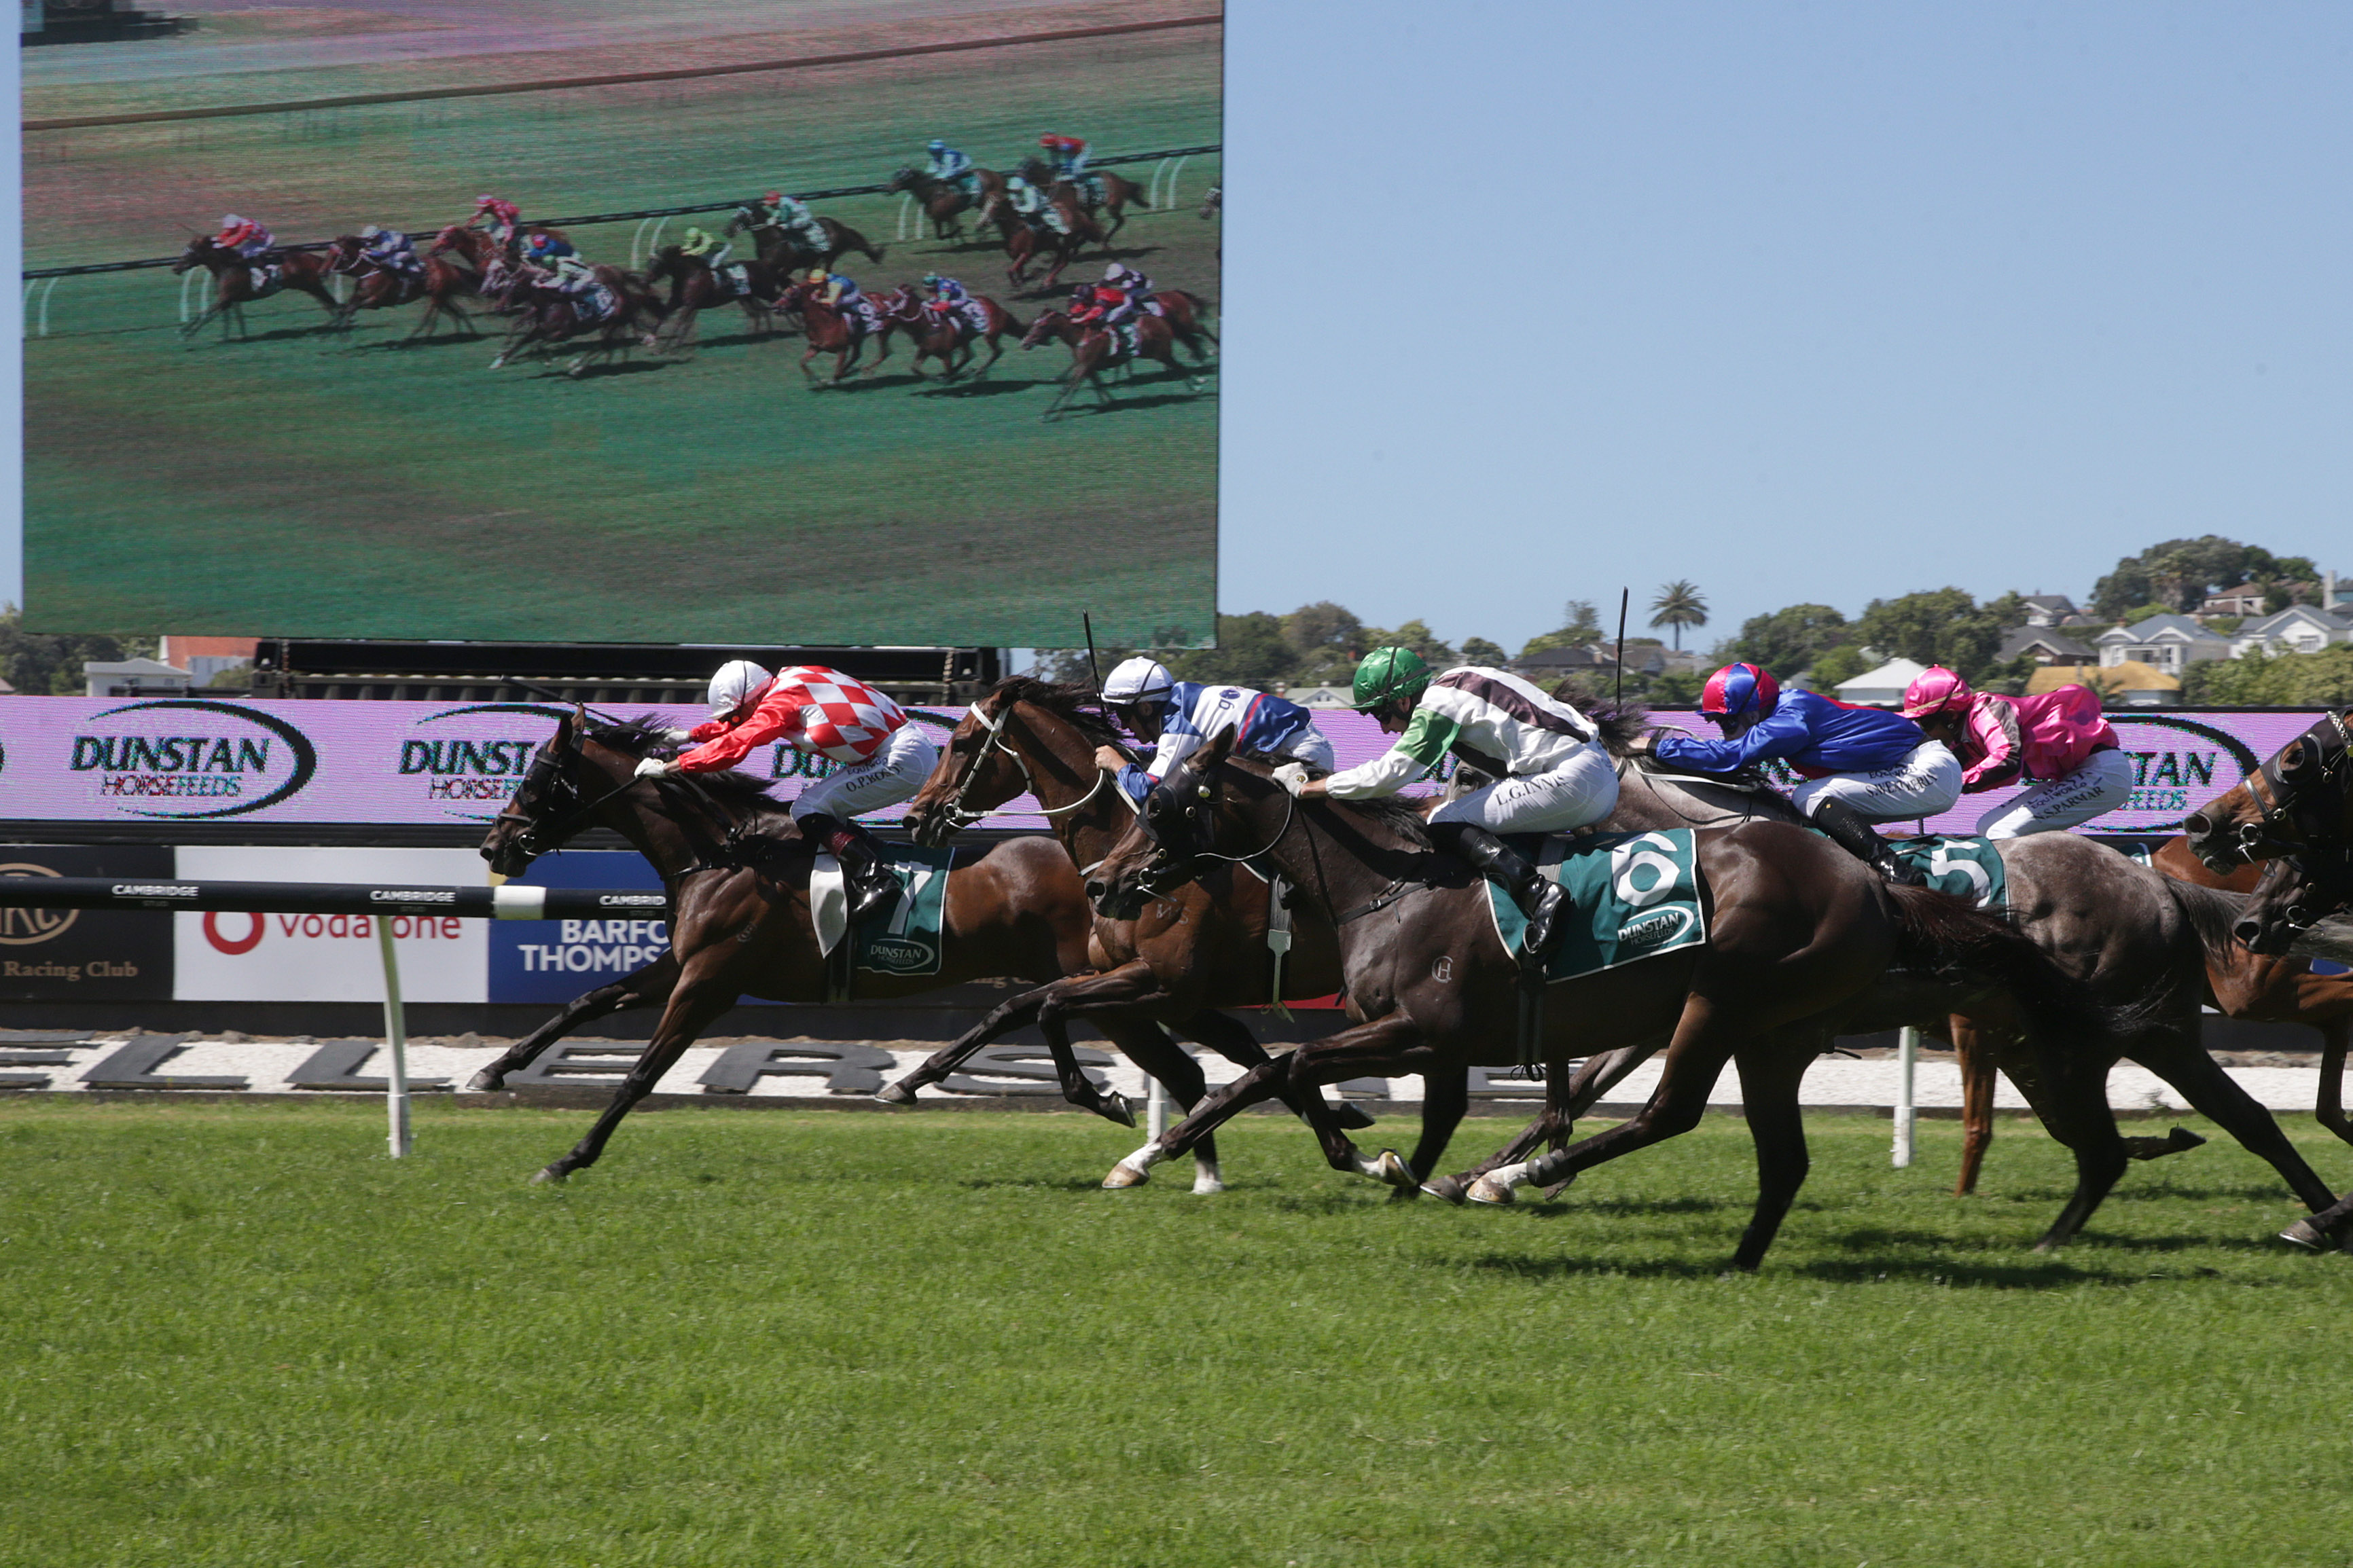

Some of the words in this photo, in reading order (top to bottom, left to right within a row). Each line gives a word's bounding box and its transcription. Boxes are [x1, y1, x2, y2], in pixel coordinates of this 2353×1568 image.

[70, 736, 269, 773] DUNSTAN
[398, 740, 537, 775] DUNST
[101, 774, 242, 797] HORSEFEEDS
[429, 777, 525, 799] HORSEF
[1611, 832, 1681, 907] 6
[1930, 840, 1992, 908] 5
[111, 885, 199, 896] CAMBRIDGE
[370, 890, 456, 902] CAMBRIDGE
[598, 895, 666, 906] CAMBRID
[887, 860, 933, 935] 7
[278, 913, 461, 939] vodaone
[561, 919, 670, 944] BARFO
[1617, 912, 1679, 942] DUNSTAN
[1630, 928, 1674, 946] HORSEFEEDS
[517, 944, 666, 972] THOMPS
[870, 945, 922, 959] DUNSTAN
[3, 961, 81, 981] Racing
[86, 961, 138, 977] Club
